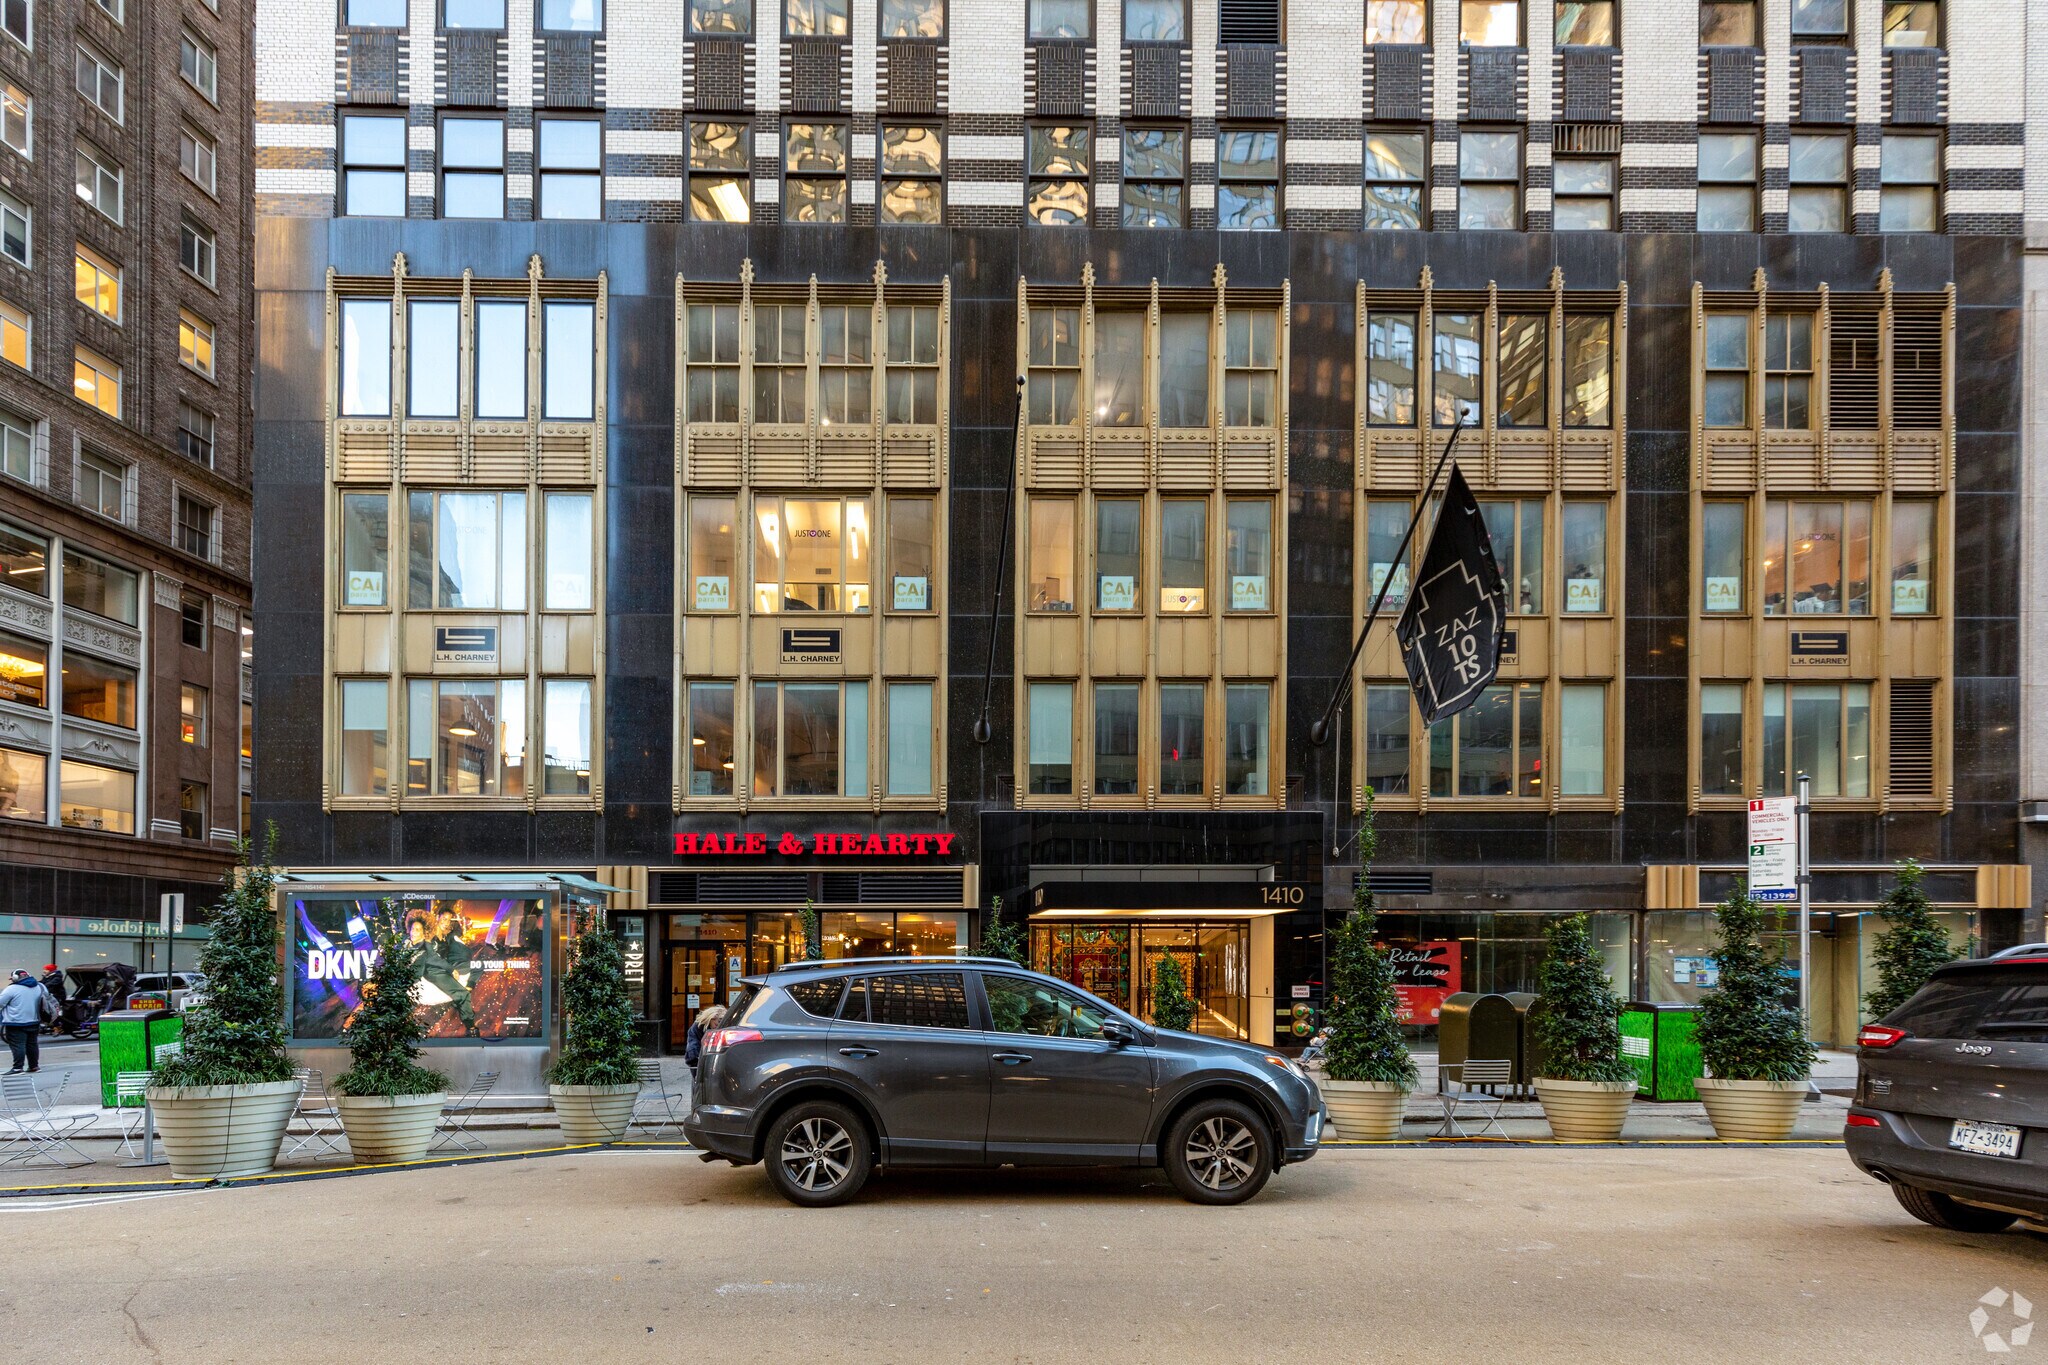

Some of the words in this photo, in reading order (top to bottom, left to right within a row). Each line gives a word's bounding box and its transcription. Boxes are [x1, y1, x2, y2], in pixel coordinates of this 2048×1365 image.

[794, 529, 810, 538] JUST
[816, 529, 831, 538] ONE
[1435, 606, 1482, 647] ZAZ
[1448, 634, 1477, 665] 10
[1453, 654, 1481, 685] TS
[1754, 801, 1760, 811] 1
[673, 833, 766, 854] HALE
[777, 831, 804, 855] &
[812, 833, 955, 855] HEARTY
[1753, 845, 1762, 856] 2
[402, 892, 436, 900] JCDecaux
[1261, 886, 1304, 904] 1410
[731, 958, 739, 967] A
[1389, 947, 1432, 963] Retail
[308, 949, 378, 980] DKNY
[470, 960, 481, 969] DO
[483, 960, 504, 969] YOUR
[507, 960, 530, 969] THING
[624, 953, 644, 984] PRET
[1412, 964, 1449, 977] lease
[1955, 1042, 1992, 1056] Jeep
[1956, 1127, 1978, 1145] KFZ
[1984, 1132, 2013, 1151] 3494
